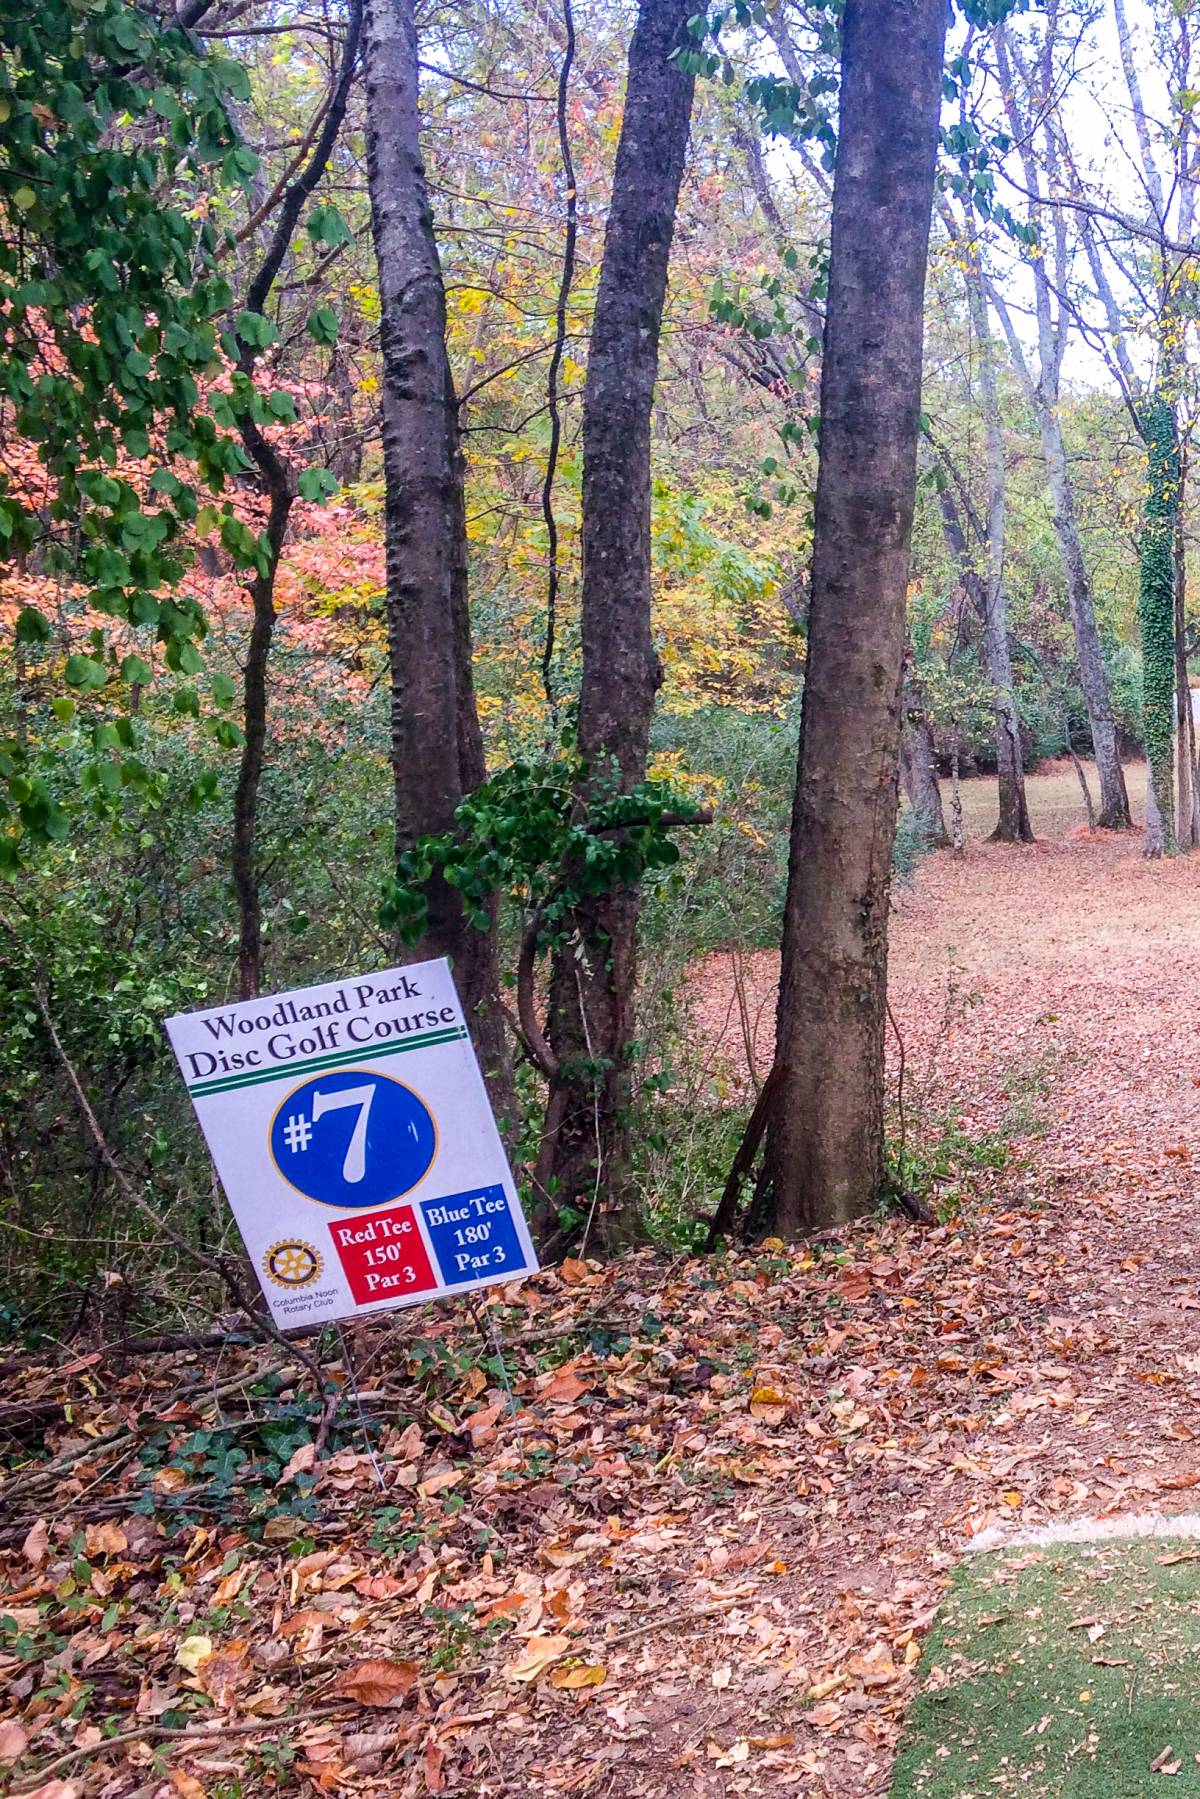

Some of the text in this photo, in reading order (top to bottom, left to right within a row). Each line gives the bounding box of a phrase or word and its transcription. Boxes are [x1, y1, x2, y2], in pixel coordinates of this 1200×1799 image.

[201, 976, 422, 1041] Woodland Park
[185, 1007, 457, 1079] Disc Golf Course
[283, 1083, 376, 1184] #7
[425, 1197, 506, 1227] Blue Tee
[337, 1218, 413, 1248] Red Tee
[453, 1222, 493, 1246] 180'
[362, 1242, 402, 1267] 150'
[455, 1245, 506, 1271] Par 3
[366, 1265, 417, 1291] Par 3
[273, 1288, 339, 1309] Columbia Noon
[283, 1298, 334, 1316] Rotary Club
